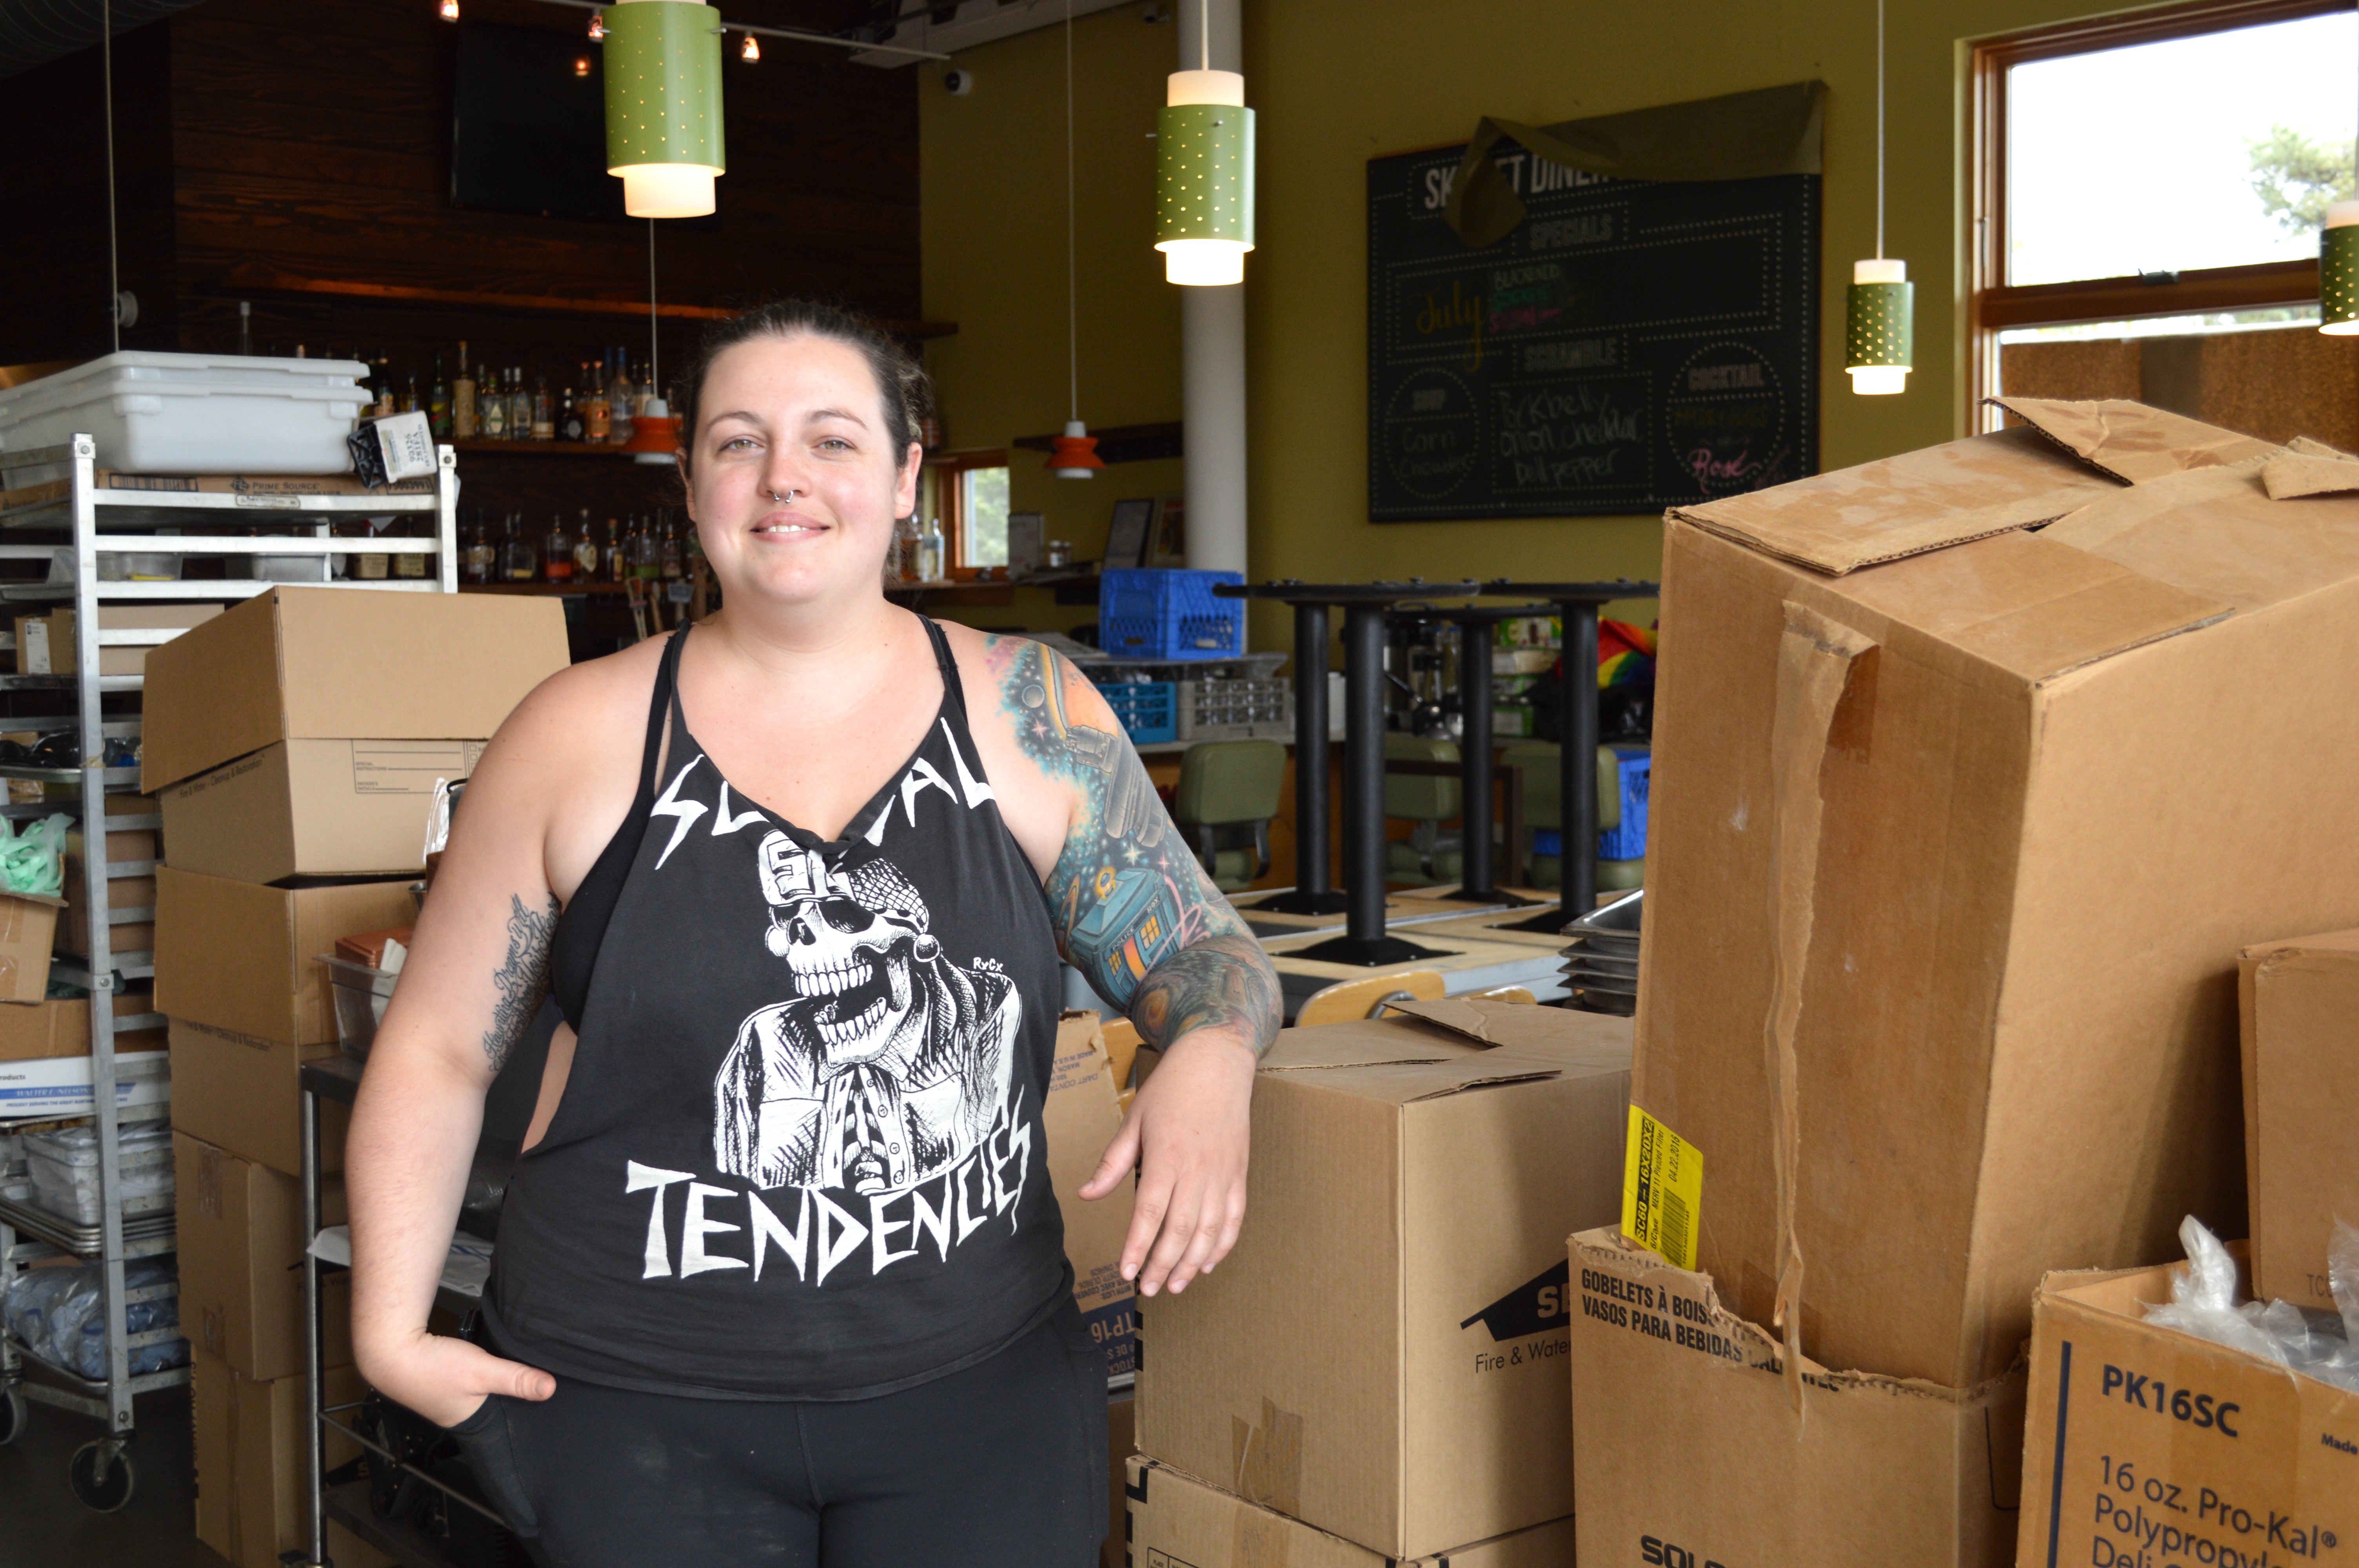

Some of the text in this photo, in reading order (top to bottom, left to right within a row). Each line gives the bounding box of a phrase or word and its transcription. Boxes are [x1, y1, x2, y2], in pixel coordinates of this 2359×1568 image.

[1528, 214, 1612, 251] SPECIALS
[1688, 363, 1765, 391] COCKTAIL
[1112, 896, 1159, 951] POLICE BOX
[1078, 1073, 1098, 1085] DART
[1668, 1134, 1680, 1183] 04.22.2016
[625, 1084, 1031, 1287] TENDENCIES
[1652, 1188, 1660, 1210] MERV
[1650, 1218, 1659, 1250] 6/Case
[1582, 1268, 1653, 1308] GOBELETS
[1582, 1294, 1627, 1327] VASOS
[1631, 1309, 1672, 1343] PARA
[1676, 1322, 1743, 1363] BEBIDAS
[1476, 1353, 1505, 1374] Fire
[1510, 1347, 1523, 1365] &
[2102, 1363, 2240, 1438] PK16SC
[2321, 1432, 2358, 1455] Made
[2101, 1455, 2135, 1492] 16
[2144, 1477, 2188, 1513] oz.
